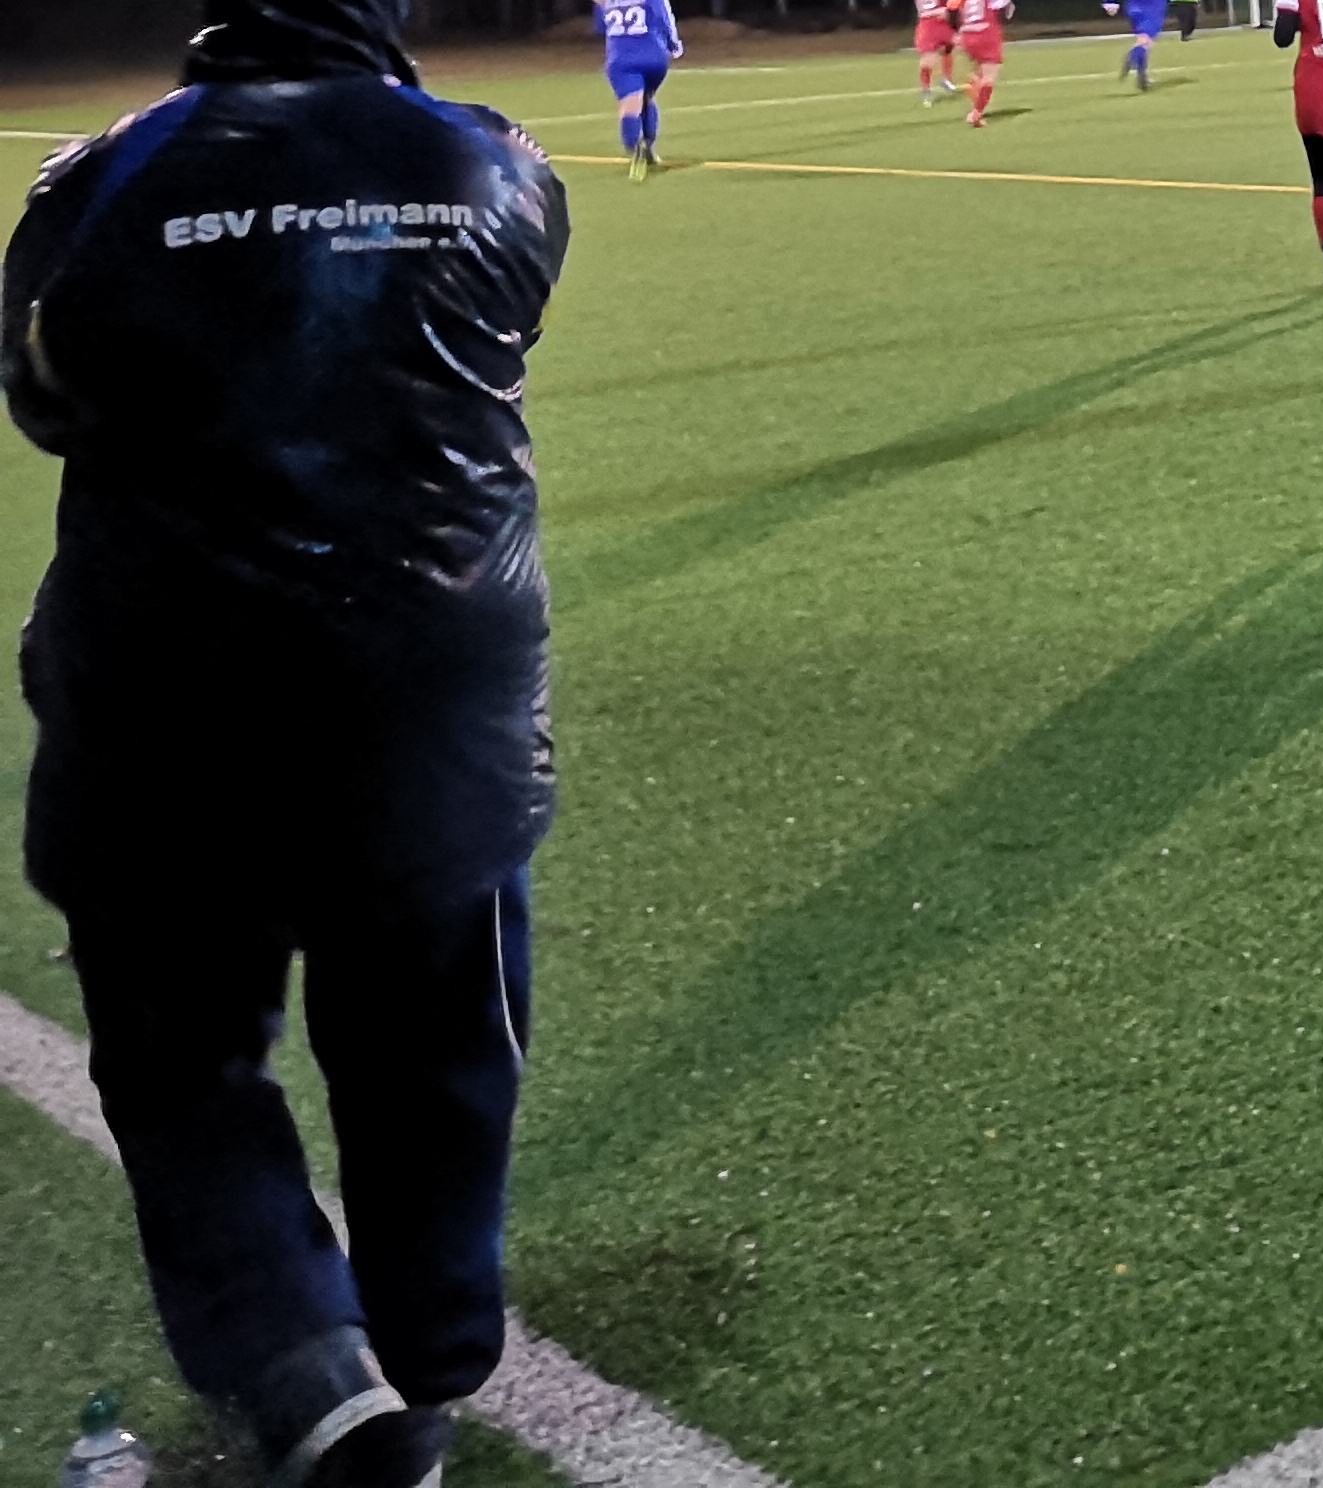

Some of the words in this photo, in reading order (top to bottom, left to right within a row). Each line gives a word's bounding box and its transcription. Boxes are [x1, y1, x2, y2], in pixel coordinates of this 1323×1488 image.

[604, 6, 648, 37] 22
[164, 209, 256, 249] ESV
[271, 199, 473, 234] Freimann
